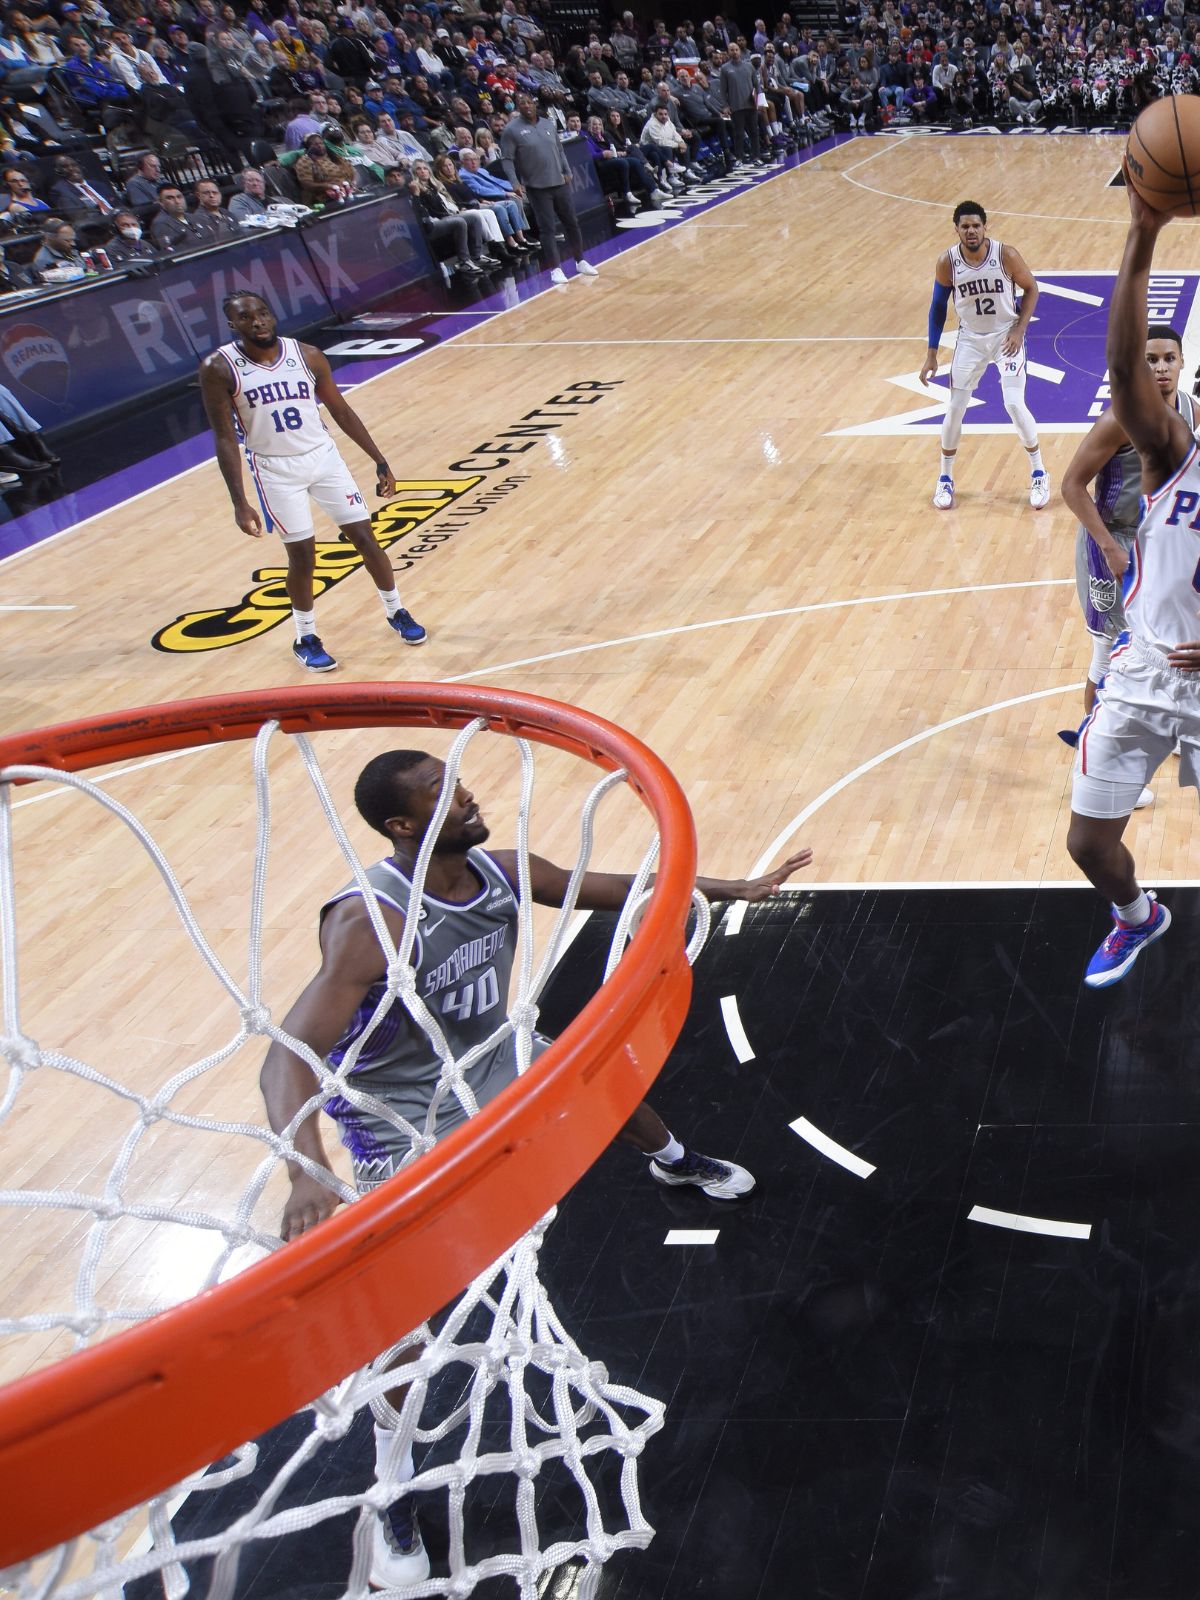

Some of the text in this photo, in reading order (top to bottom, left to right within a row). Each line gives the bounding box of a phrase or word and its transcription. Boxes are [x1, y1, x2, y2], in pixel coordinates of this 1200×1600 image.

[958, 126, 1116, 135] Ankr
[661, 163, 785, 208] dialpad
[958, 278, 1005, 298] PHILA
[111, 235, 359, 375] RE/MAX
[975, 298, 997, 316] 12
[11, 342, 58, 368] RE/MAX
[1004, 361, 1017, 372] 76
[244, 381, 310, 409] PHILA
[271, 406, 303, 433] 18
[448, 379, 626, 472] CENTER
[345, 491, 362, 506] 76
[448, 475, 532, 517] Union
[1090, 590, 1115, 601] KINGS
[487, 894, 512, 910] dialpad
[423, 922, 509, 999] SACRAMENTO
[441, 965, 500, 1021] 40
